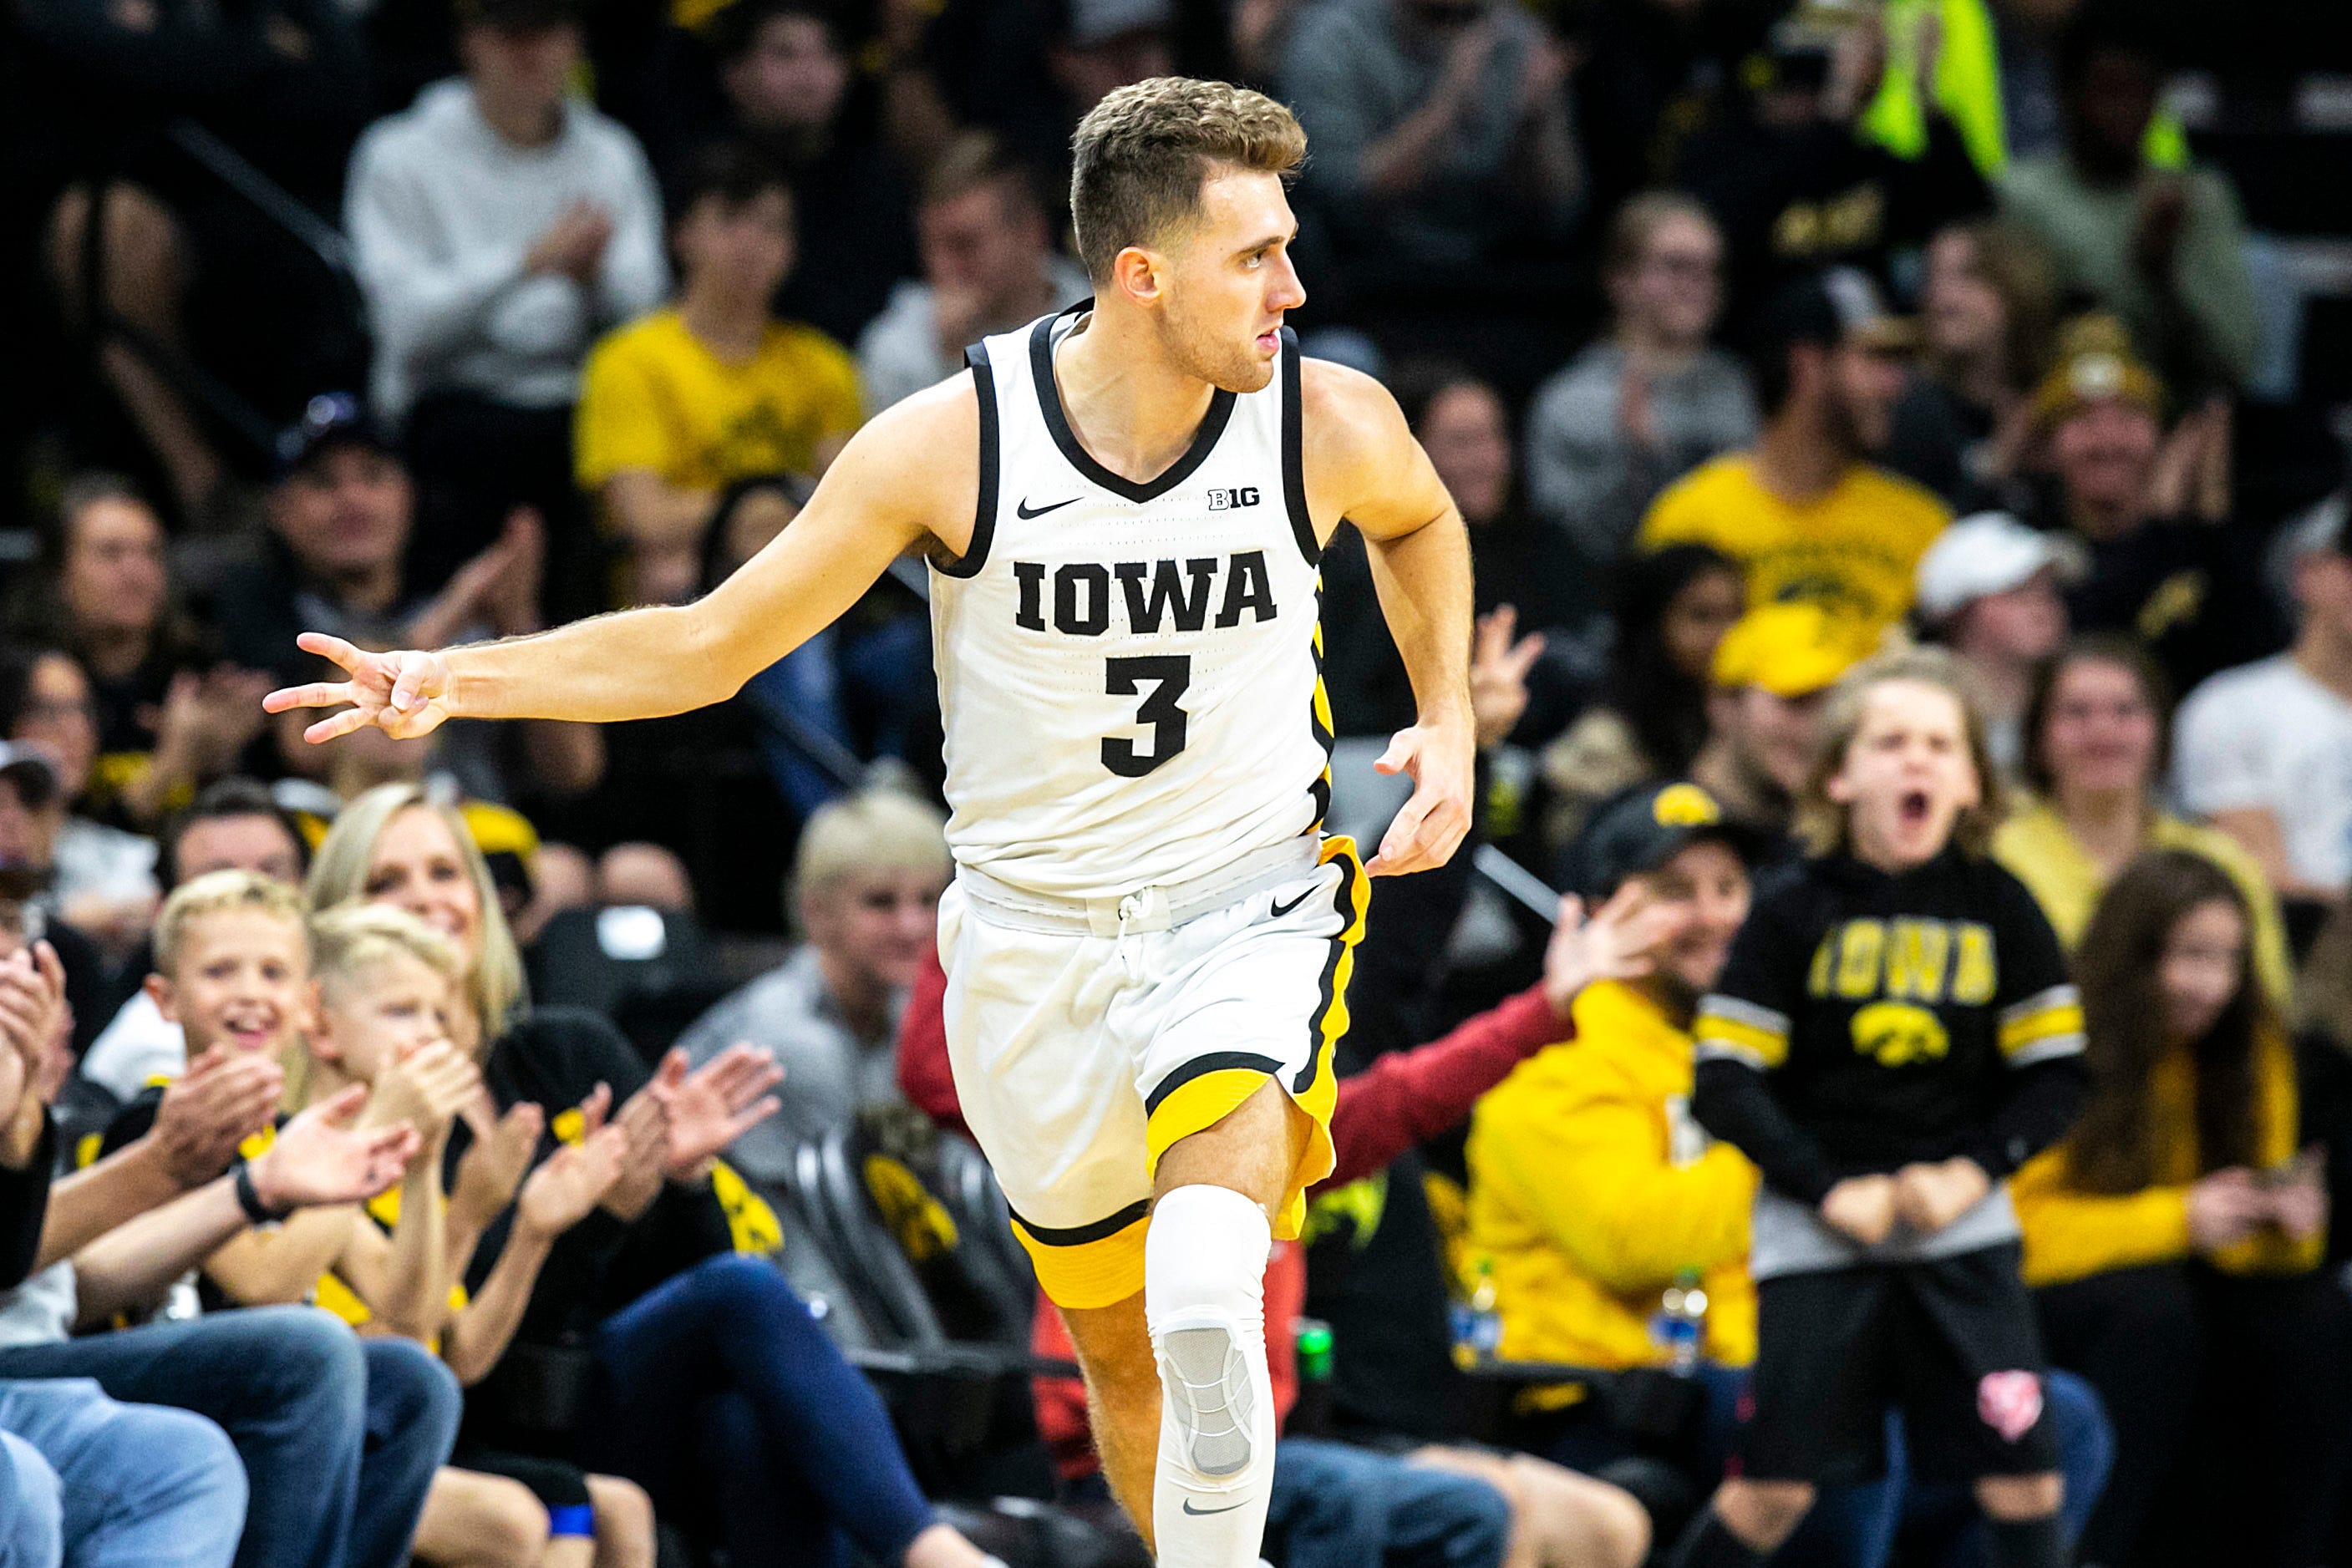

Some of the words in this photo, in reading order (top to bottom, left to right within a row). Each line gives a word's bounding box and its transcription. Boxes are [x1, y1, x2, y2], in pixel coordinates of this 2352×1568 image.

[1013, 551, 1278, 637] IOWA
[1101, 655, 1191, 778] 3
[1807, 915, 1997, 1004] IOWA
